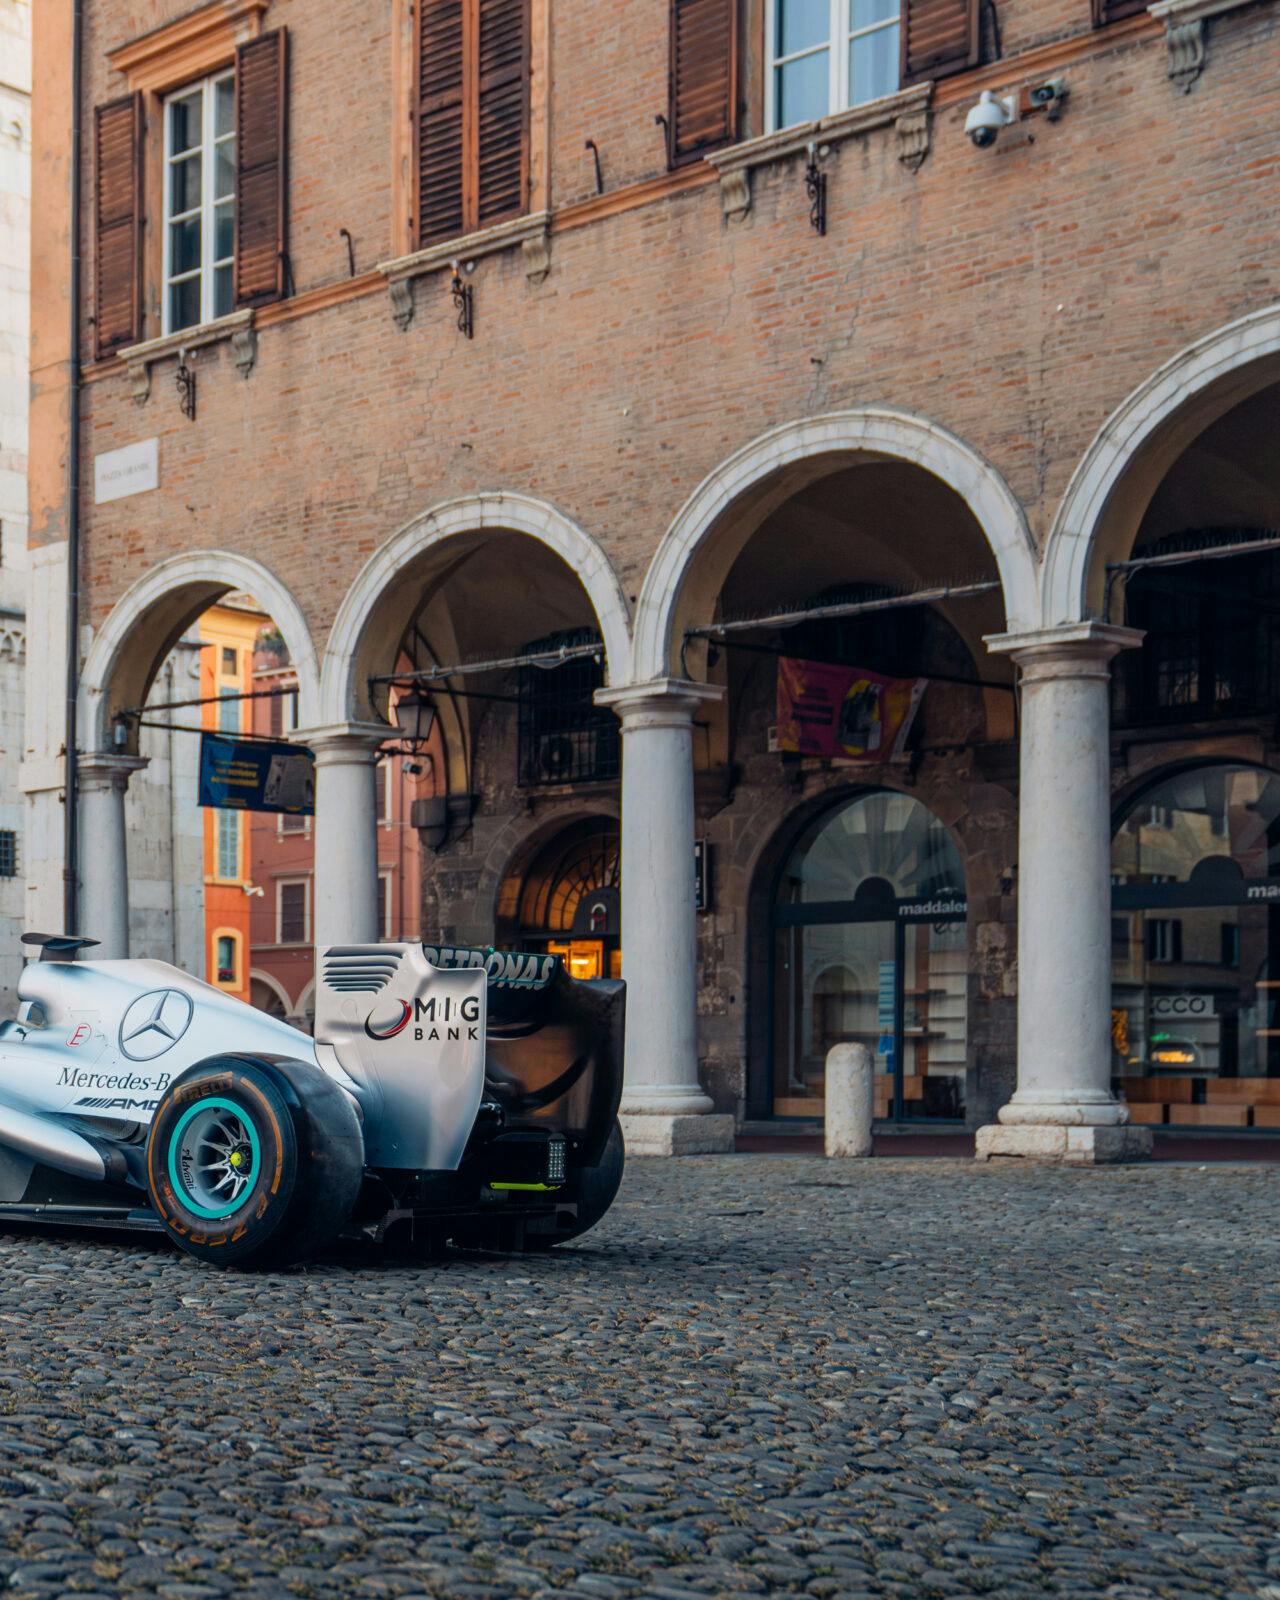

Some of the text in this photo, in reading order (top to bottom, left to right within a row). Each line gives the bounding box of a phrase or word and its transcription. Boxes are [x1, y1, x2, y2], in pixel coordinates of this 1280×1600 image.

[68, 1025, 88, 1045] E
[414, 1027, 479, 1041] BANK
[56, 1066, 171, 1091] Mercedes-B
